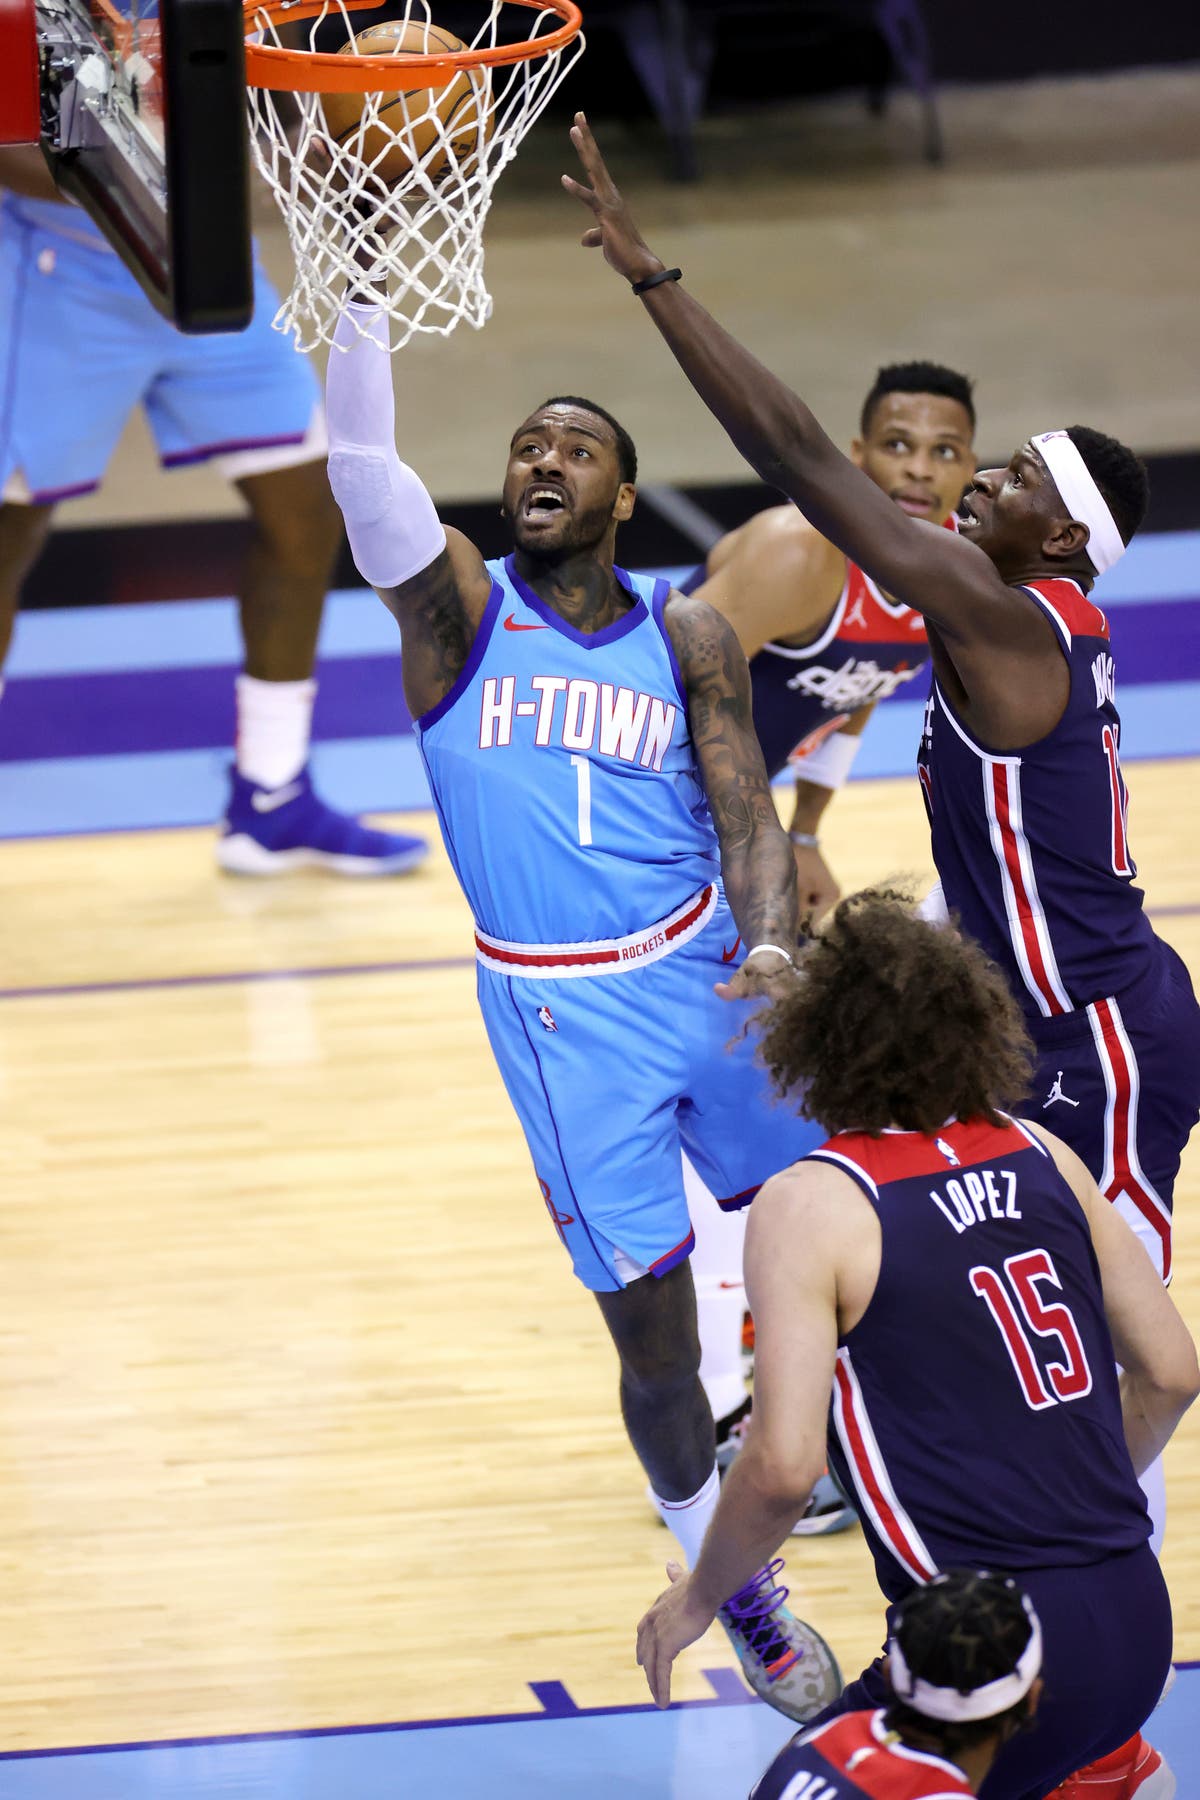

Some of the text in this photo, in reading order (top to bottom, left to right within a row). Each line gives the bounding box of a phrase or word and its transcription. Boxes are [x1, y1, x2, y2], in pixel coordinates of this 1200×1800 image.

[479, 676, 676, 773] H-TOWN
[570, 754, 593, 847] 1
[622, 933, 664, 960] ROCKETS
[930, 1171, 1022, 1234] LOPEZ
[969, 1248, 1093, 1411] 15
